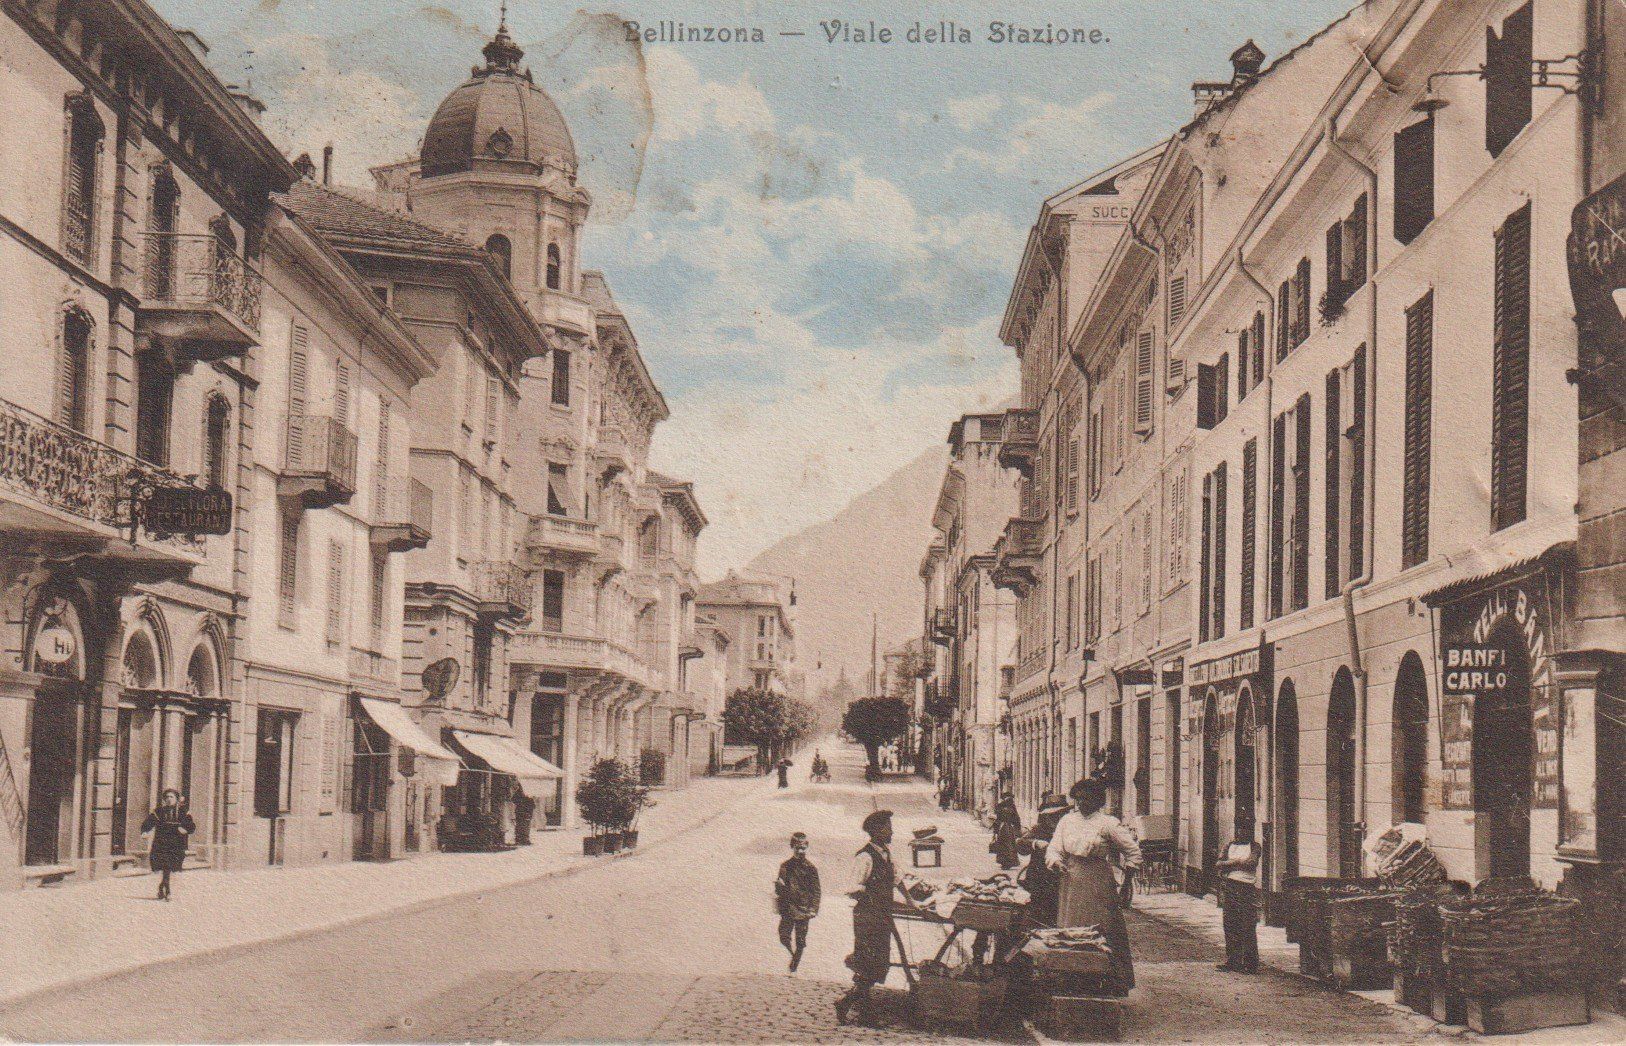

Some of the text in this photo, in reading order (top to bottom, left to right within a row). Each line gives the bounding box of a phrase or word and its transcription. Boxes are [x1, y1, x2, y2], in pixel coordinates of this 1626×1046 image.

[149, 511, 229, 529] ESTAURANT
[1446, 648, 1506, 667] BANFI
[1445, 671, 1507, 690] CARLO
